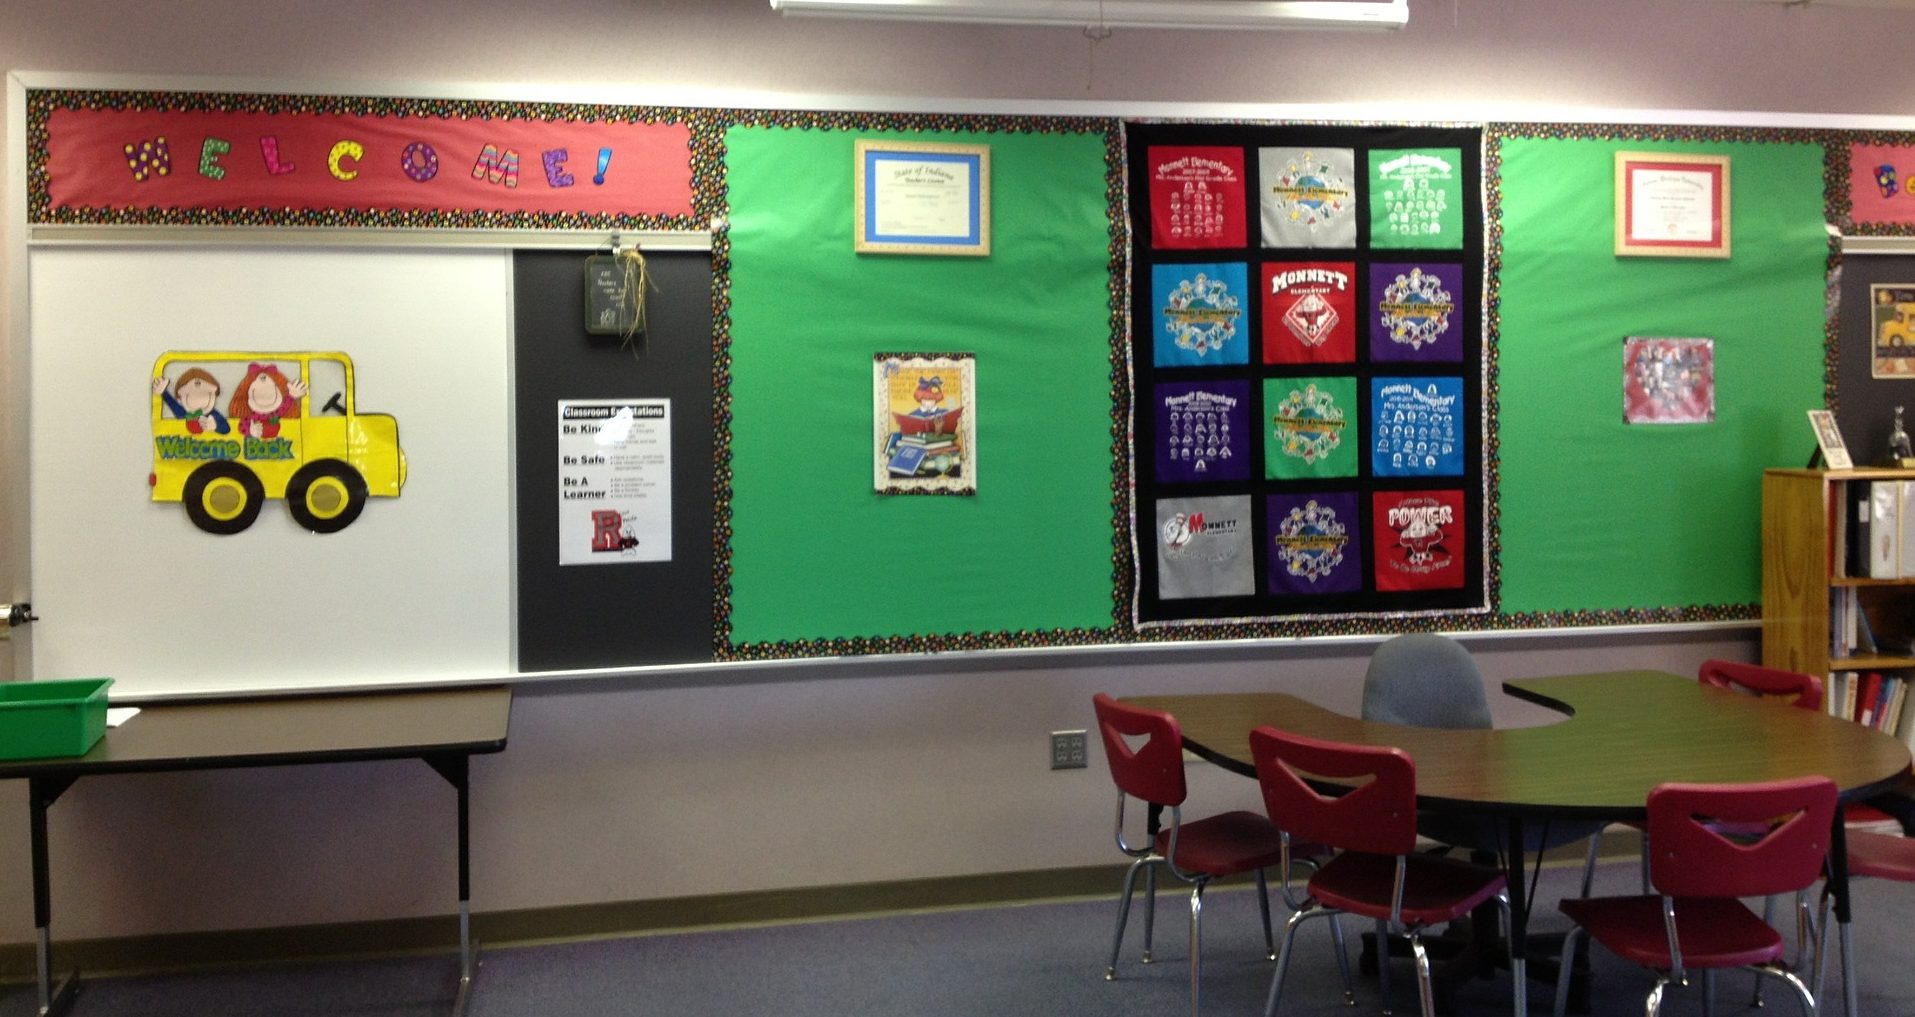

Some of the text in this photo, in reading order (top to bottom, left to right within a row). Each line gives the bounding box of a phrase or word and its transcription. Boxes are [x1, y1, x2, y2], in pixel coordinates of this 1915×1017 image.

[123, 136, 614, 189] WELCOME!
[914, 165, 924, 176] of
[1272, 268, 1348, 294] MONNETT
[1290, 287, 1331, 295] ELEMENTARY
[1165, 391, 1237, 408] Monnett Elementary
[1381, 384, 1455, 407] Monnett Elementary
[565, 406, 609, 418] Classroom
[563, 425, 577, 434] Be
[155, 434, 295, 460] Welcome Back
[563, 455, 577, 465] Be
[581, 455, 605, 465] Safe
[563, 476, 589, 486] Be A
[563, 489, 606, 500] Learner
[1188, 511, 1237, 534] MONNETT
[1388, 505, 1453, 527] POWER
[592, 509, 622, 553] R
